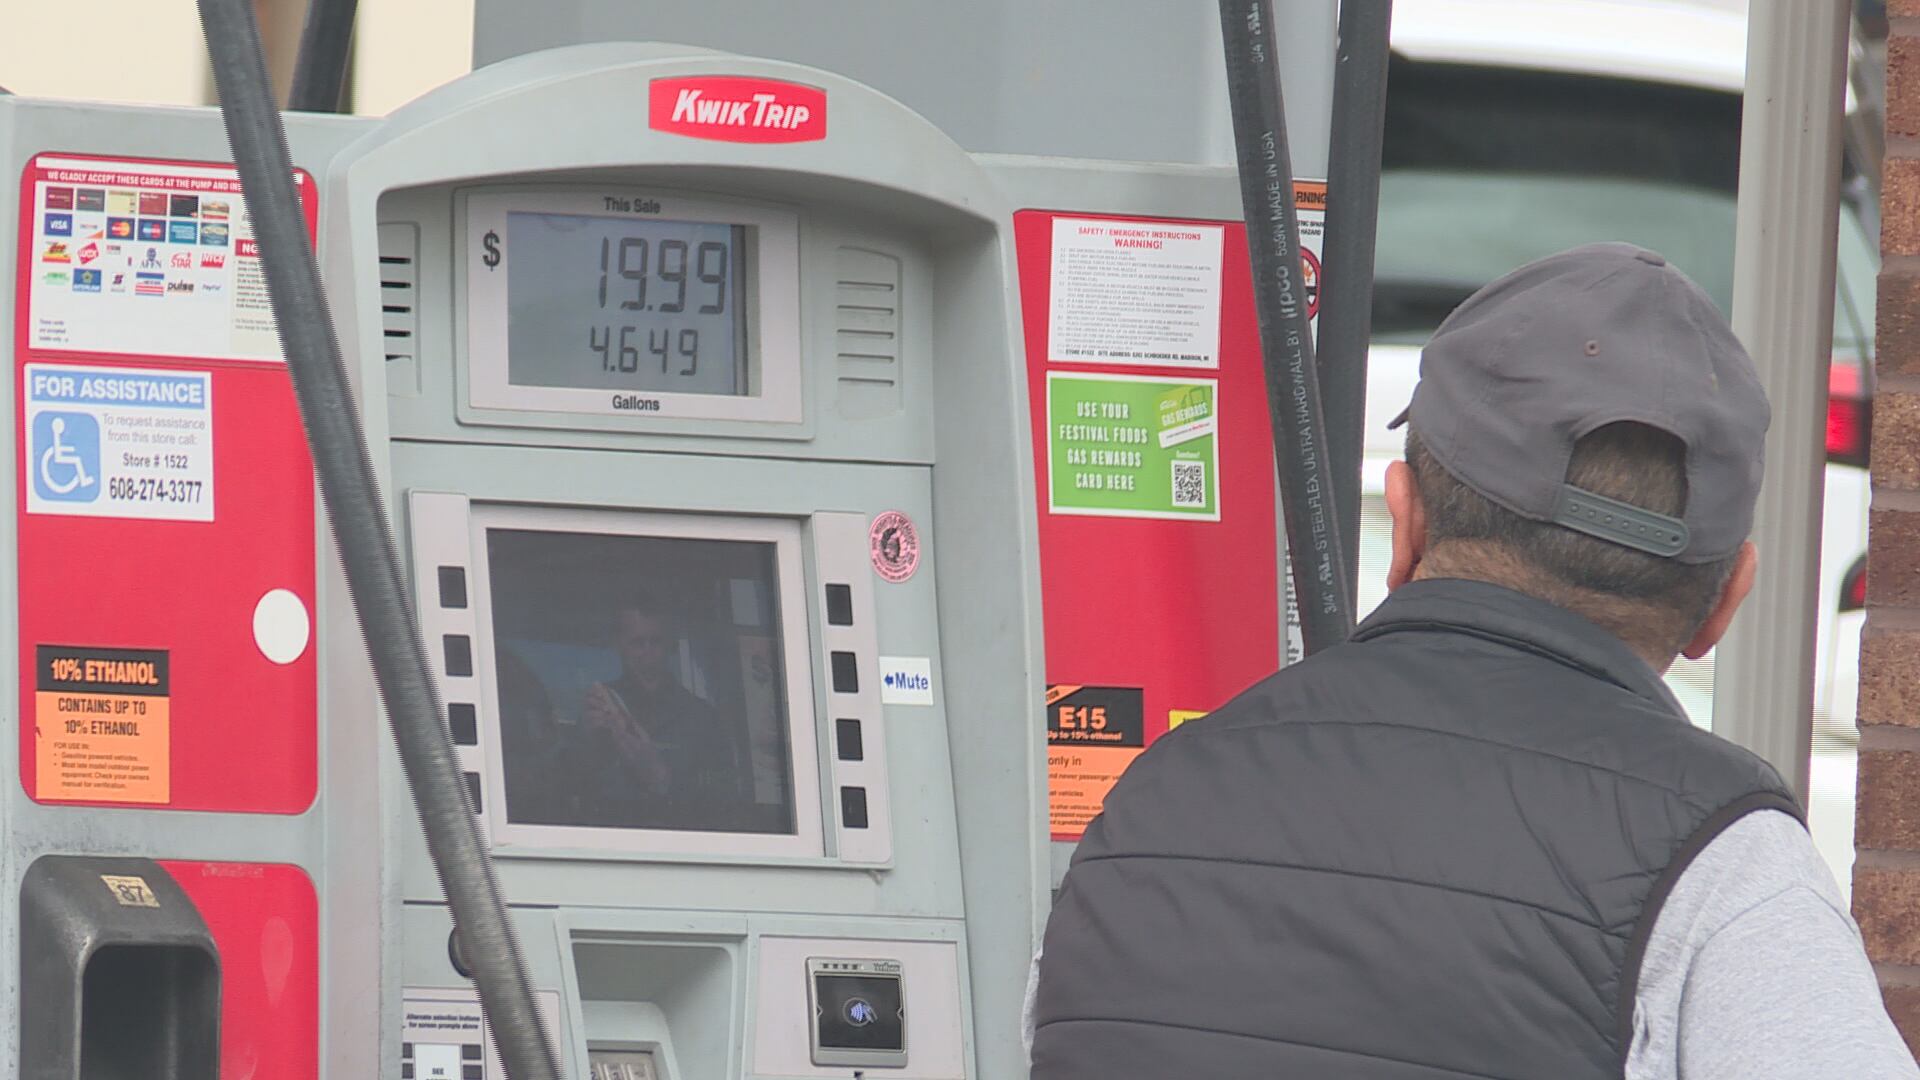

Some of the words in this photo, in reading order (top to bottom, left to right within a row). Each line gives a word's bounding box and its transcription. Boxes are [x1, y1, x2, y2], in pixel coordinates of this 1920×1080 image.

[671, 88, 751, 126] KWIK
[752, 92, 810, 129] TRIP
[1262, 130, 1276, 162] USA
[47, 170, 59, 180] WE
[59, 171, 87, 182] GLADLY
[87, 173, 116, 183] ACCEPT
[116, 175, 139, 185] THESE
[140, 176, 165, 187] CARDS
[165, 178, 175, 188] AT
[175, 178, 190, 189] THE
[190, 179, 213, 190] PUMP
[213, 181, 229, 191] AND
[603, 195, 631, 213] This
[633, 197, 661, 215] Sale
[1266, 180, 1285, 222] MADE
[49, 219, 68, 230] VISA
[1078, 226, 1104, 236] SAFETY
[1109, 228, 1150, 238] EMERGENCY
[1151, 231, 1201, 241] INSTRUCTIONS
[1114, 238, 1163, 250] WARNING!
[171, 258, 192, 269] STAR
[482, 229, 501, 273] $
[600, 236, 728, 315] 19.99
[167, 279, 194, 292] pulse
[589, 326, 699, 377] 4.649
[34, 375, 74, 398] FOR
[79, 378, 201, 404] ASSISTANCE
[612, 394, 660, 411] Gallons
[1077, 401, 1097, 418] USE
[1101, 402, 1129, 419] YOUR
[103, 412, 114, 426] To
[116, 416, 153, 428] request
[154, 416, 206, 430] assistance
[107, 429, 130, 442] from
[132, 431, 149, 443] this
[151, 433, 176, 444] store
[1059, 424, 1110, 442] FESTIVAL
[1113, 427, 1148, 444] FOODS
[1300, 425, 1316, 471] ULTRA
[123, 451, 151, 468] Store
[164, 454, 188, 470] 1522
[1067, 448, 1087, 465] GAS
[1091, 450, 1142, 468] REWARDS
[109, 477, 202, 504] 608-274-3377
[1076, 473, 1103, 489] CARD
[1107, 475, 1135, 491] HERE
[1306, 473, 1328, 551] STEELFLEX
[51, 658, 82, 682] 10%
[84, 660, 159, 685] ETHANOL
[895, 672, 929, 691] Mute
[58, 697, 111, 714] CONTAINS
[114, 700, 130, 715] UP
[133, 701, 146, 716] TO
[1059, 706, 1107, 730] E15
[64, 719, 88, 735] 10%
[91, 720, 140, 737] ETHANOL
[1059, 731, 1070, 740] to
[1071, 731, 1089, 740] 15%
[1090, 732, 1122, 741] ethanol
[1047, 756, 1070, 769] only
[1071, 755, 1082, 766] in
[117, 884, 145, 903] 87
[431, 1067, 444, 1075] SEE
